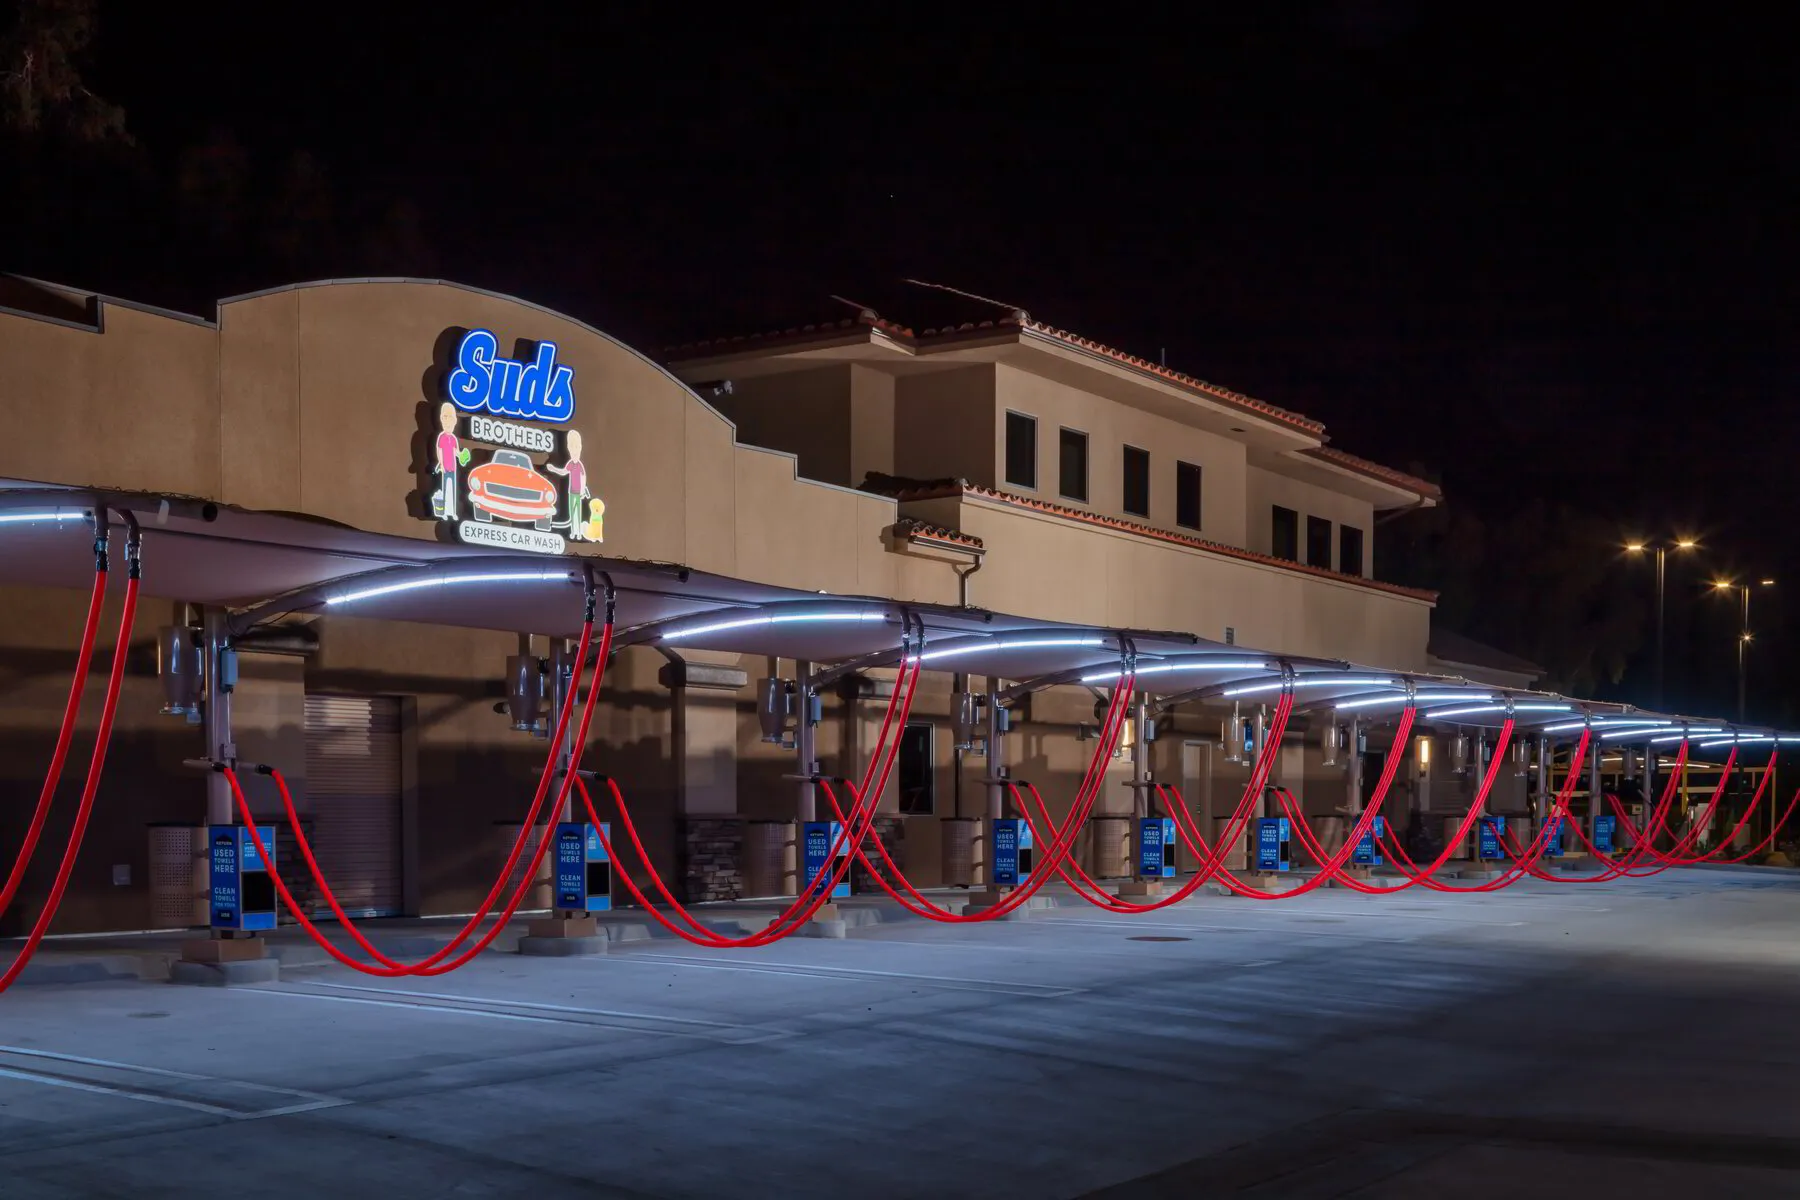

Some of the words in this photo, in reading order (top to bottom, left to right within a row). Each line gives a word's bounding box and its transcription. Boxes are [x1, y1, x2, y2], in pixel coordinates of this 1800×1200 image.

[449, 330, 574, 422] Suds
[474, 420, 552, 448] BROTHERS
[464, 526, 508, 542] EXPRESS
[511, 533, 530, 545] CAR
[534, 536, 560, 550] WASH
[214, 849, 234, 857] USED
